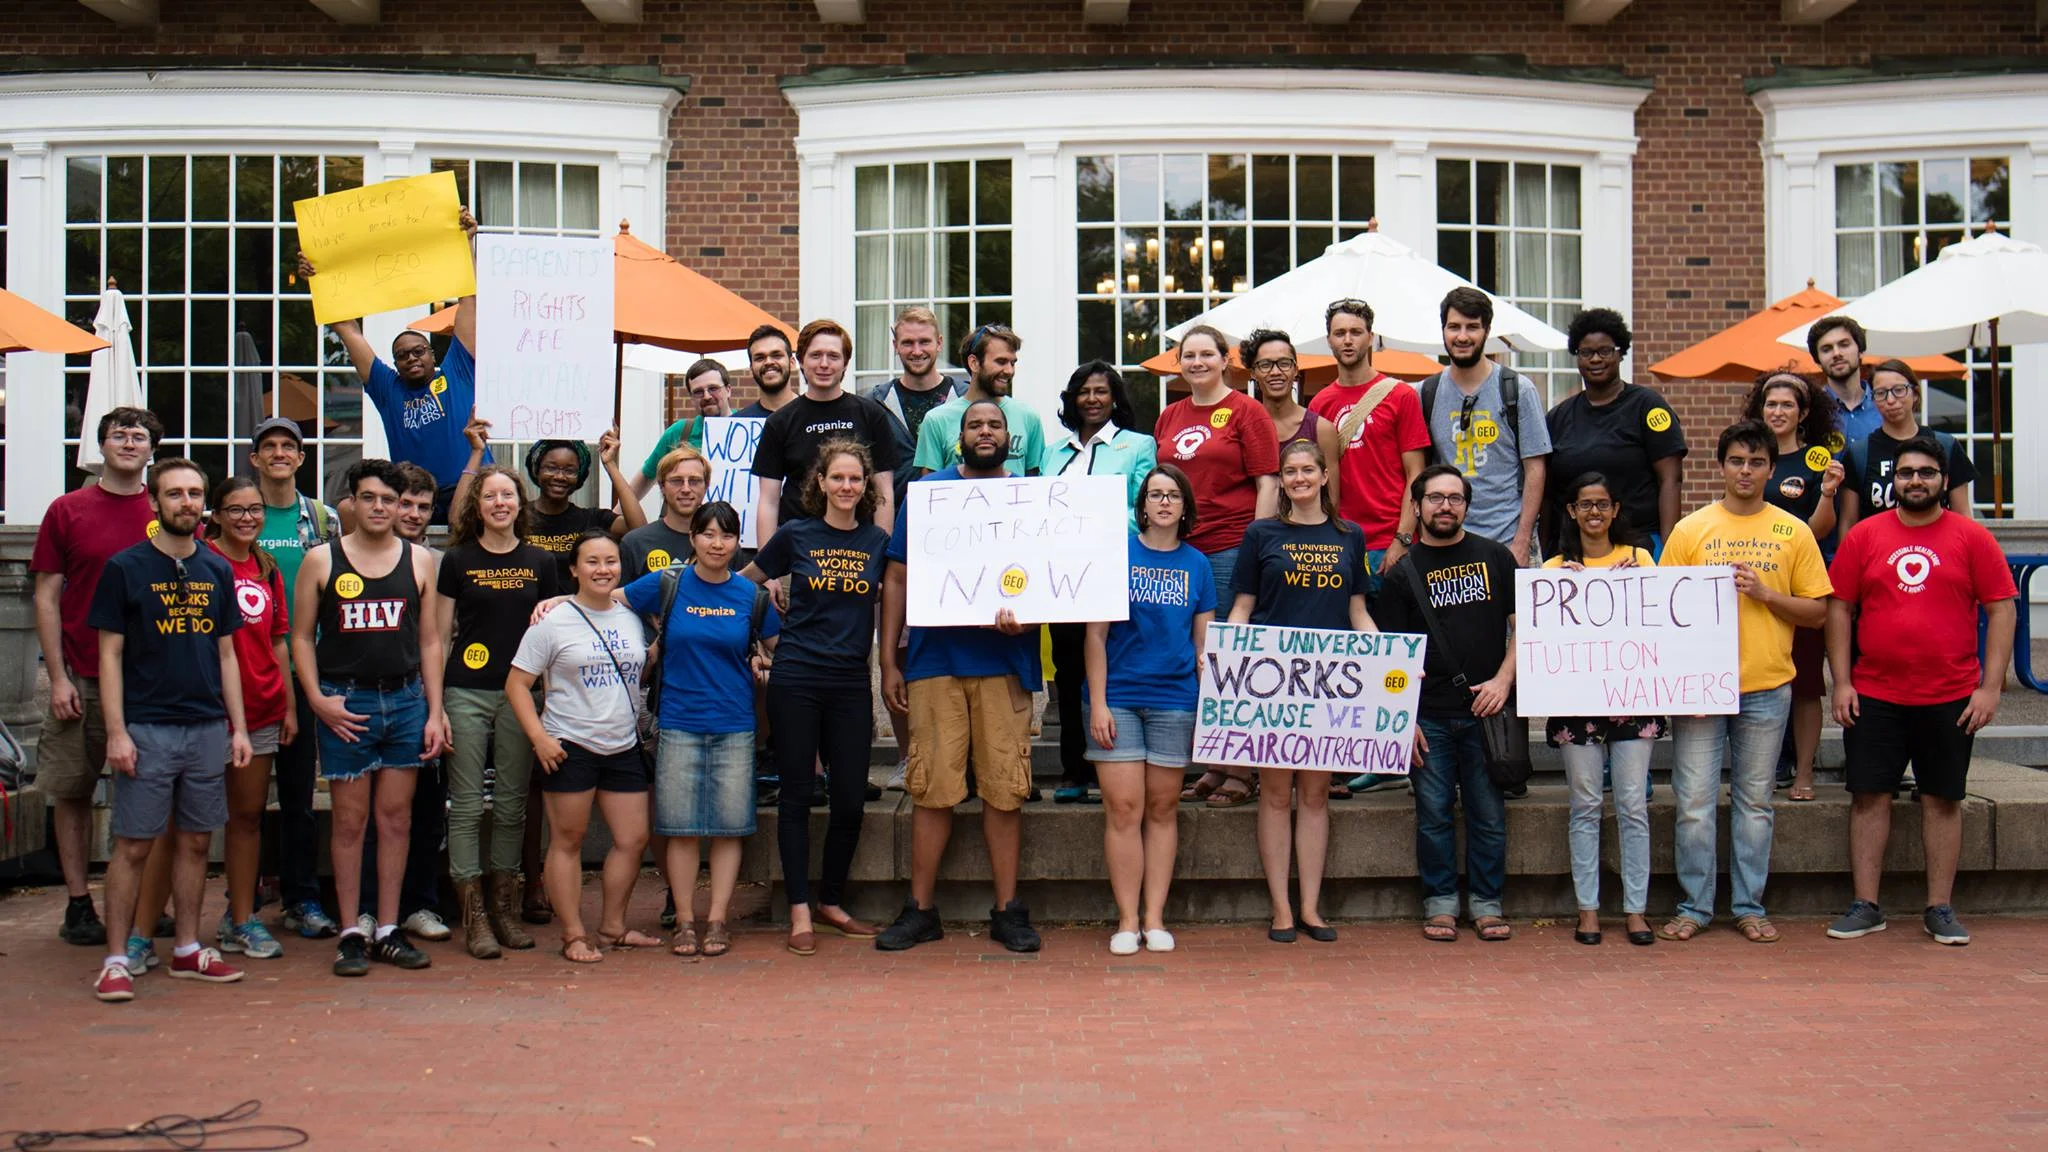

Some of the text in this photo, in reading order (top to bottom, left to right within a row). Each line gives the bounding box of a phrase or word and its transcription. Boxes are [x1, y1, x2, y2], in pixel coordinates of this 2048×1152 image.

[312, 231, 346, 249] have
[513, 289, 585, 321] RIGHTS
[485, 361, 590, 403] HUMAN
[510, 404, 583, 438] RIGHTS
[805, 419, 853, 434] organize
[1649, 411, 1668, 428] GEO
[1477, 426, 1495, 437] GEO
[704, 420, 762, 463] WOR
[1808, 450, 1829, 467] GEO
[706, 468, 752, 503] WIT
[928, 481, 1069, 515] FAIR
[923, 515, 1092, 556] CONTRACT
[1772, 523, 1793, 536] GEO
[1298, 543, 1344, 552] UNIVERSITY
[1705, 538, 1780, 551] all workers
[809, 549, 871, 561] THE UNIVERSITY
[1289, 552, 1339, 564] WORKS
[1713, 550, 1761, 558] deserve
[649, 556, 668, 568] GEO
[816, 558, 865, 571] WORKS
[1296, 563, 1333, 572] BECAUSE
[1705, 558, 1779, 572] livin wage
[487, 568, 534, 578] BARGAIN
[821, 568, 858, 579] BECAUSE
[1284, 570, 1343, 588] WE DO
[151, 582, 215, 592] THE UERSITY
[339, 580, 360, 592] GEO
[502, 580, 524, 589] BEG
[808, 576, 870, 594] WE DO
[1003, 574, 1024, 589] GEO
[1131, 577, 1184, 592] TUITION
[1428, 574, 1484, 596] TUITION
[1529, 576, 1730, 628] PROTECT
[168, 607, 204, 617] BECAUSE
[341, 601, 404, 629] HLV
[686, 605, 736, 617] organize
[156, 618, 214, 634] WE DO
[1208, 624, 1422, 659] THE UNIVERSITY
[466, 648, 485, 662] GEO
[1522, 640, 1659, 675] TUITION
[578, 661, 642, 676] TUITON
[1207, 652, 1363, 700] WORKS
[1385, 676, 1405, 689] GEO
[1603, 672, 1737, 709] WAIVERS
[1201, 697, 1409, 734] BECAUSE WE DO
[1198, 728, 1410, 772] #FAIRCONTRACTNOW
